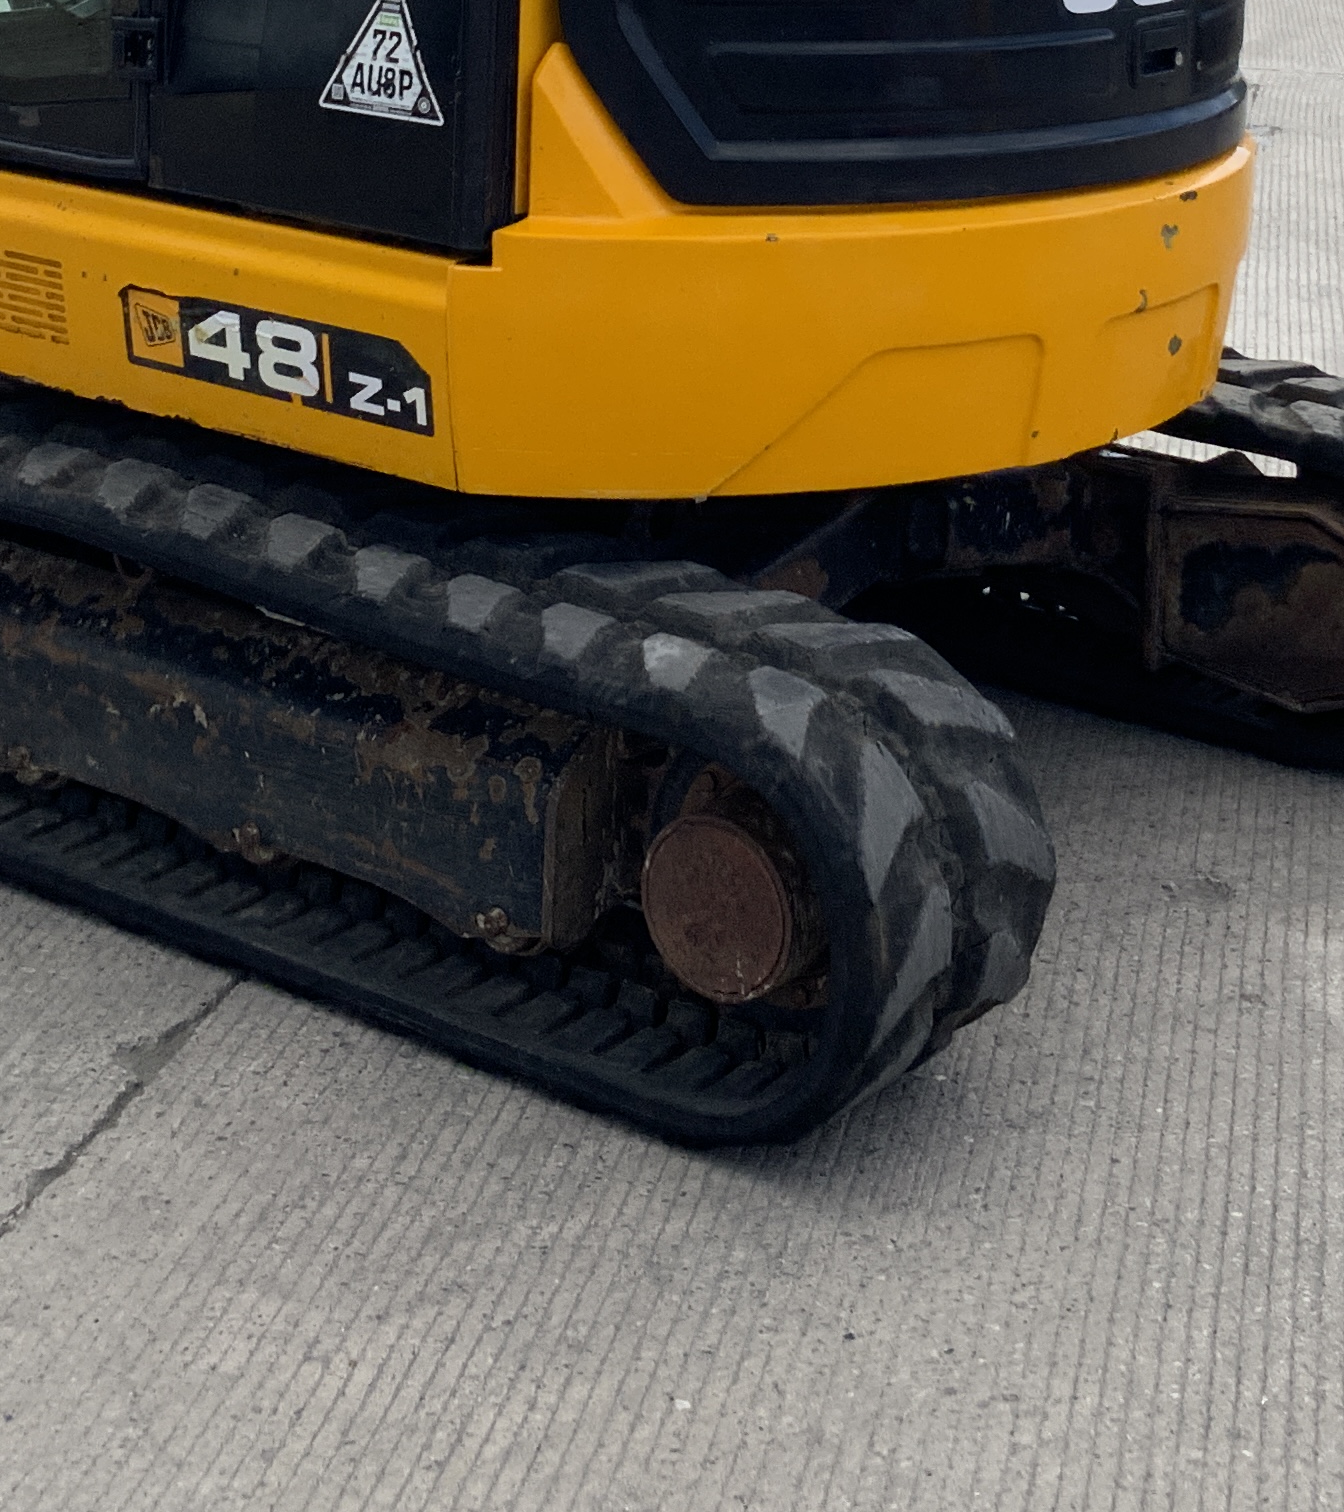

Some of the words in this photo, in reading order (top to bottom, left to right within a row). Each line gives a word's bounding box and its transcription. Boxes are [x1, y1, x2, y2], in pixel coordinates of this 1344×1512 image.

[372, 29, 402, 64] 72
[350, 61, 413, 101] AU8P
[187, 309, 320, 397] 48
[348, 371, 428, 427] Z-1
